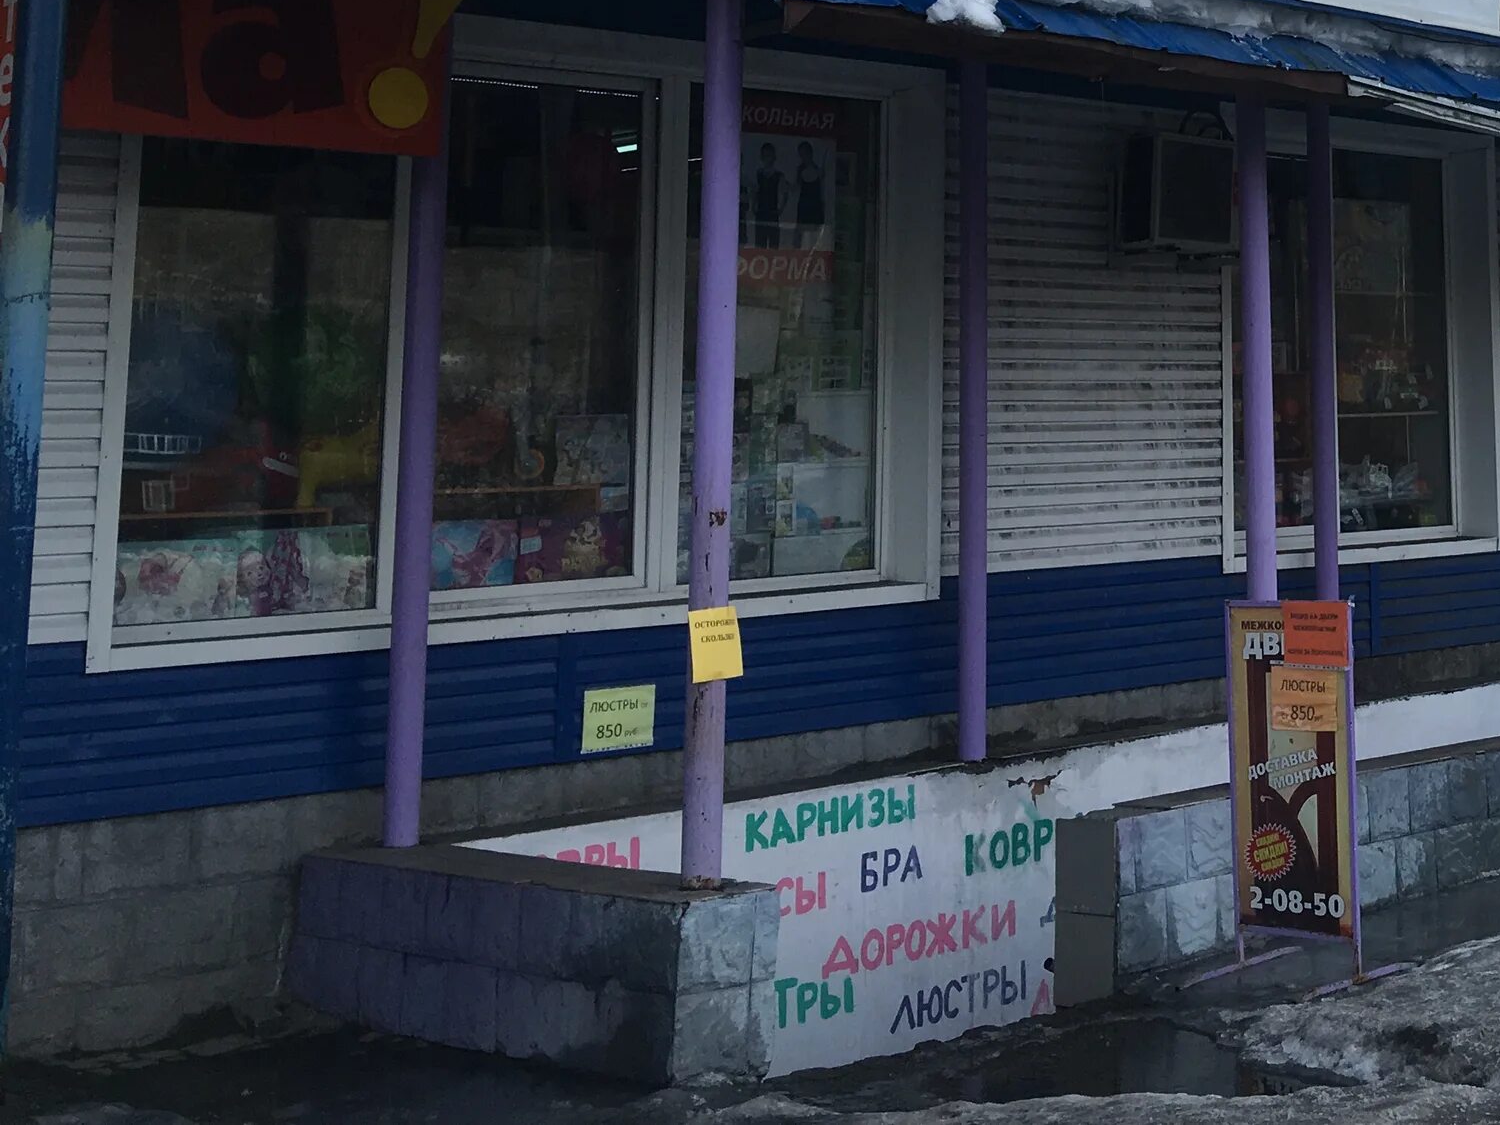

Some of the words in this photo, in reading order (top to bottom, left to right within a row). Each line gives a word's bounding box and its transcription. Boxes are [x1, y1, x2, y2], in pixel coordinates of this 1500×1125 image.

[742, 105, 836, 131] КОЛЬНАЯ
[1241, 620, 1285, 631] МЕЖКО
[1242, 632, 1285, 661] ДВ
[1280, 679, 1326, 694] ЛЮСТРЫ
[589, 698, 639, 714] ЛЮСТРЫ
[1290, 705, 1316, 720] 850
[596, 723, 622, 739] 850
[1247, 748, 1319, 781] ДОСТАВКА
[1271, 761, 1337, 790] МОНТАЖ
[745, 784, 917, 853] КАРНИЗЫ
[964, 817, 1055, 877] КОВР
[860, 845, 923, 893] БРА
[776, 871, 827, 917] СЫ
[1249, 886, 1346, 920] 2-08-50
[821, 899, 1017, 980] ДОРОЖКИ
[889, 960, 1028, 1035] ЛЮСТРЫ
